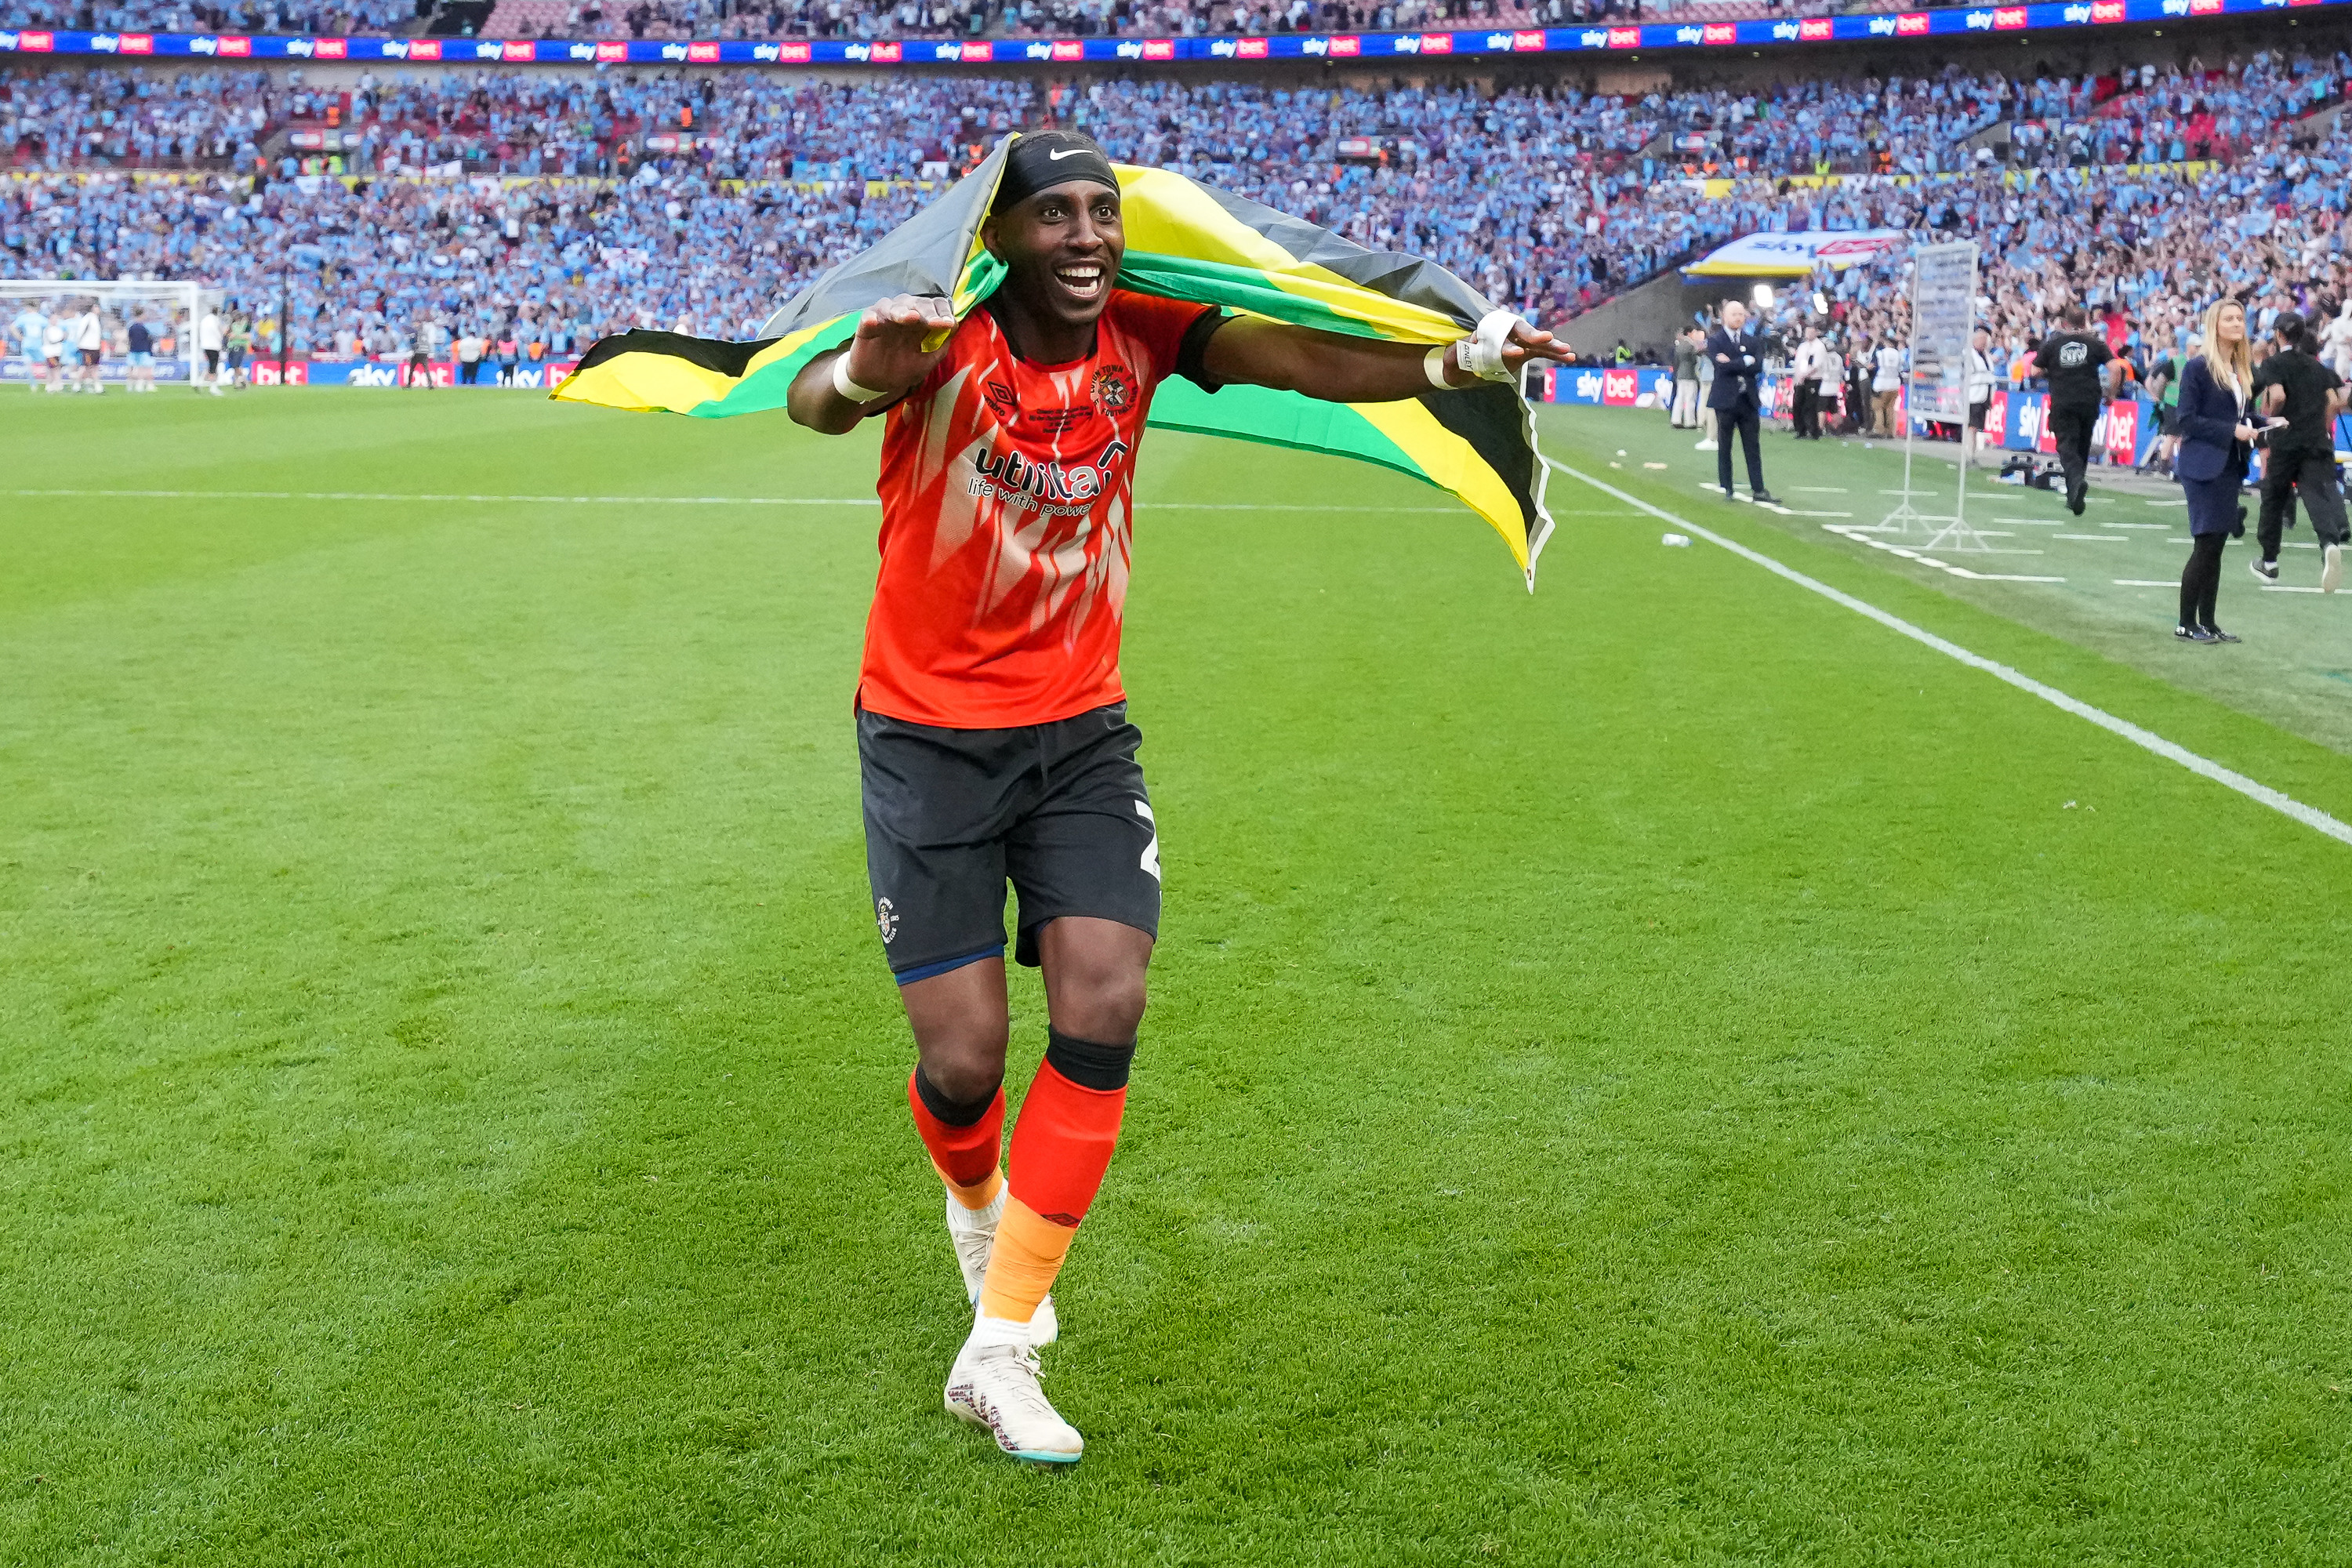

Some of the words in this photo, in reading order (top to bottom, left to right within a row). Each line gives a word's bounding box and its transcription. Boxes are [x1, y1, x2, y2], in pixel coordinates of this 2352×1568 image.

[1967, 10, 1995, 30] sky
[1994, 10, 2024, 25] bet
[2065, 4, 2093, 23] sky
[2092, 4, 2122, 18] bet
[1774, 22, 1802, 40] sky
[1801, 22, 1828, 35] bet
[1870, 17, 1898, 35] sky
[1897, 16, 1926, 31] bet
[0, 31, 20, 50] ky
[21, 34, 49, 48] bet
[92, 34, 120, 52] sky
[119, 36, 148, 50] bet
[1395, 35, 1422, 53] sky
[1421, 37, 1449, 49] bet
[1488, 33, 1515, 50] sky
[1515, 33, 1543, 47] bet
[1581, 30, 1610, 48] sky
[1609, 31, 1637, 44] bet
[1677, 26, 1705, 44] sky
[1704, 27, 1733, 40] bet
[191, 37, 218, 55] sky
[220, 39, 246, 53] bet
[288, 39, 315, 57] sky
[317, 42, 342, 54] bet
[383, 40, 410, 59] sky
[409, 42, 437, 56] bet
[477, 42, 504, 60] sky
[503, 43, 532, 56] bet
[570, 43, 597, 60] sky
[598, 44, 624, 58] bet
[662, 43, 689, 61] sky
[691, 45, 716, 58] bet
[754, 44, 780, 61] sky
[782, 45, 807, 58] bet
[845, 44, 872, 61] sky
[873, 45, 898, 58] bet
[936, 43, 962, 60] sky
[964, 45, 989, 57] bet
[1027, 42, 1053, 60] sky
[1052, 42, 1080, 56] bet
[1117, 42, 1145, 59] sky
[1144, 42, 1171, 55] bet
[1211, 40, 1238, 57] sky
[1237, 41, 1265, 54] bet
[1303, 38, 1330, 56] sky
[1330, 39, 1356, 52] bet
[349, 364, 396, 387] sky
[1577, 371, 1603, 403] sky
[1606, 372, 1635, 398] bet
[2019, 396, 2042, 448] sky
[2109, 406, 2134, 451] bet
[975, 447, 1102, 499] utilita
[967, 477, 994, 497] life
[998, 487, 1038, 512] with
[1040, 503, 1091, 517] powe
